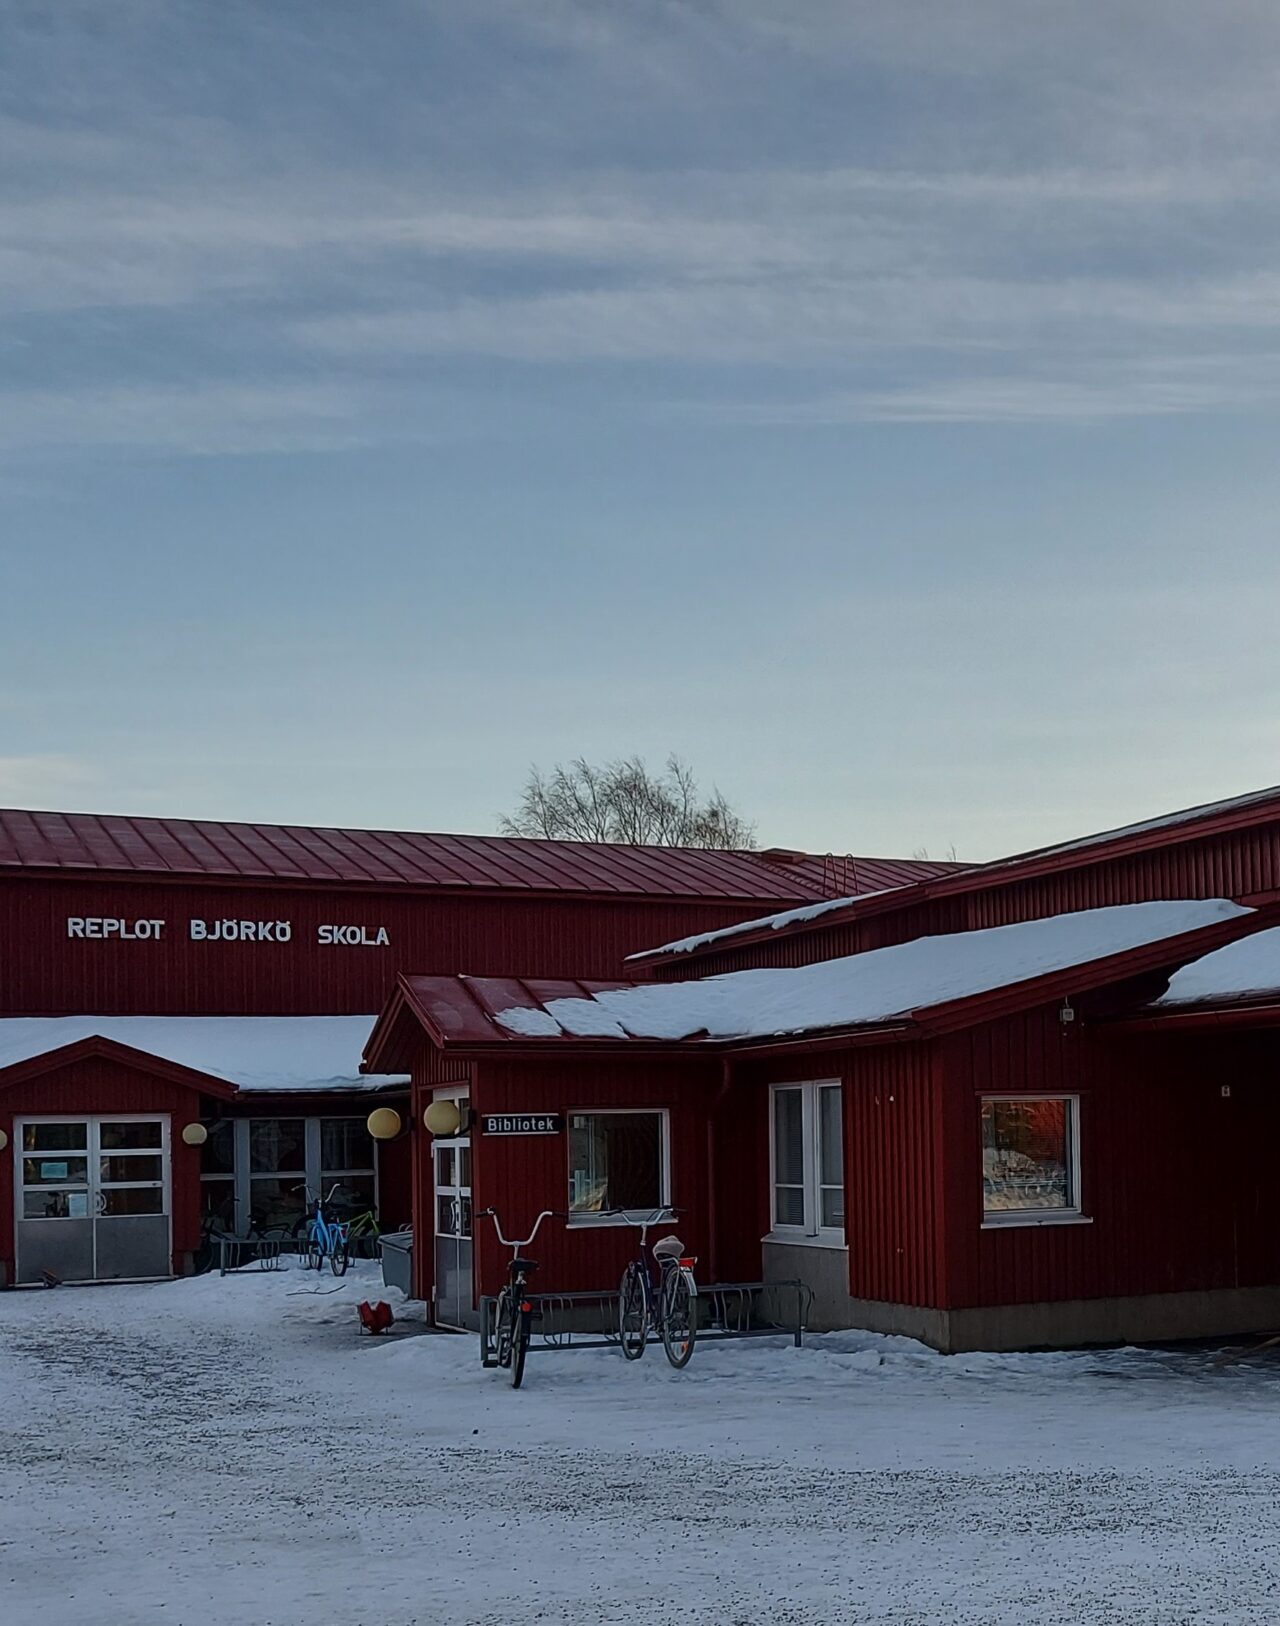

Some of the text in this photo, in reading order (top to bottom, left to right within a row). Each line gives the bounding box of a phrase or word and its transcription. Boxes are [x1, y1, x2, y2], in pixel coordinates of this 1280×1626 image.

[67, 917, 390, 945] REPLOT BJÖRKÖ SKOLA
[488, 1117, 554, 1131] Bibliotek
